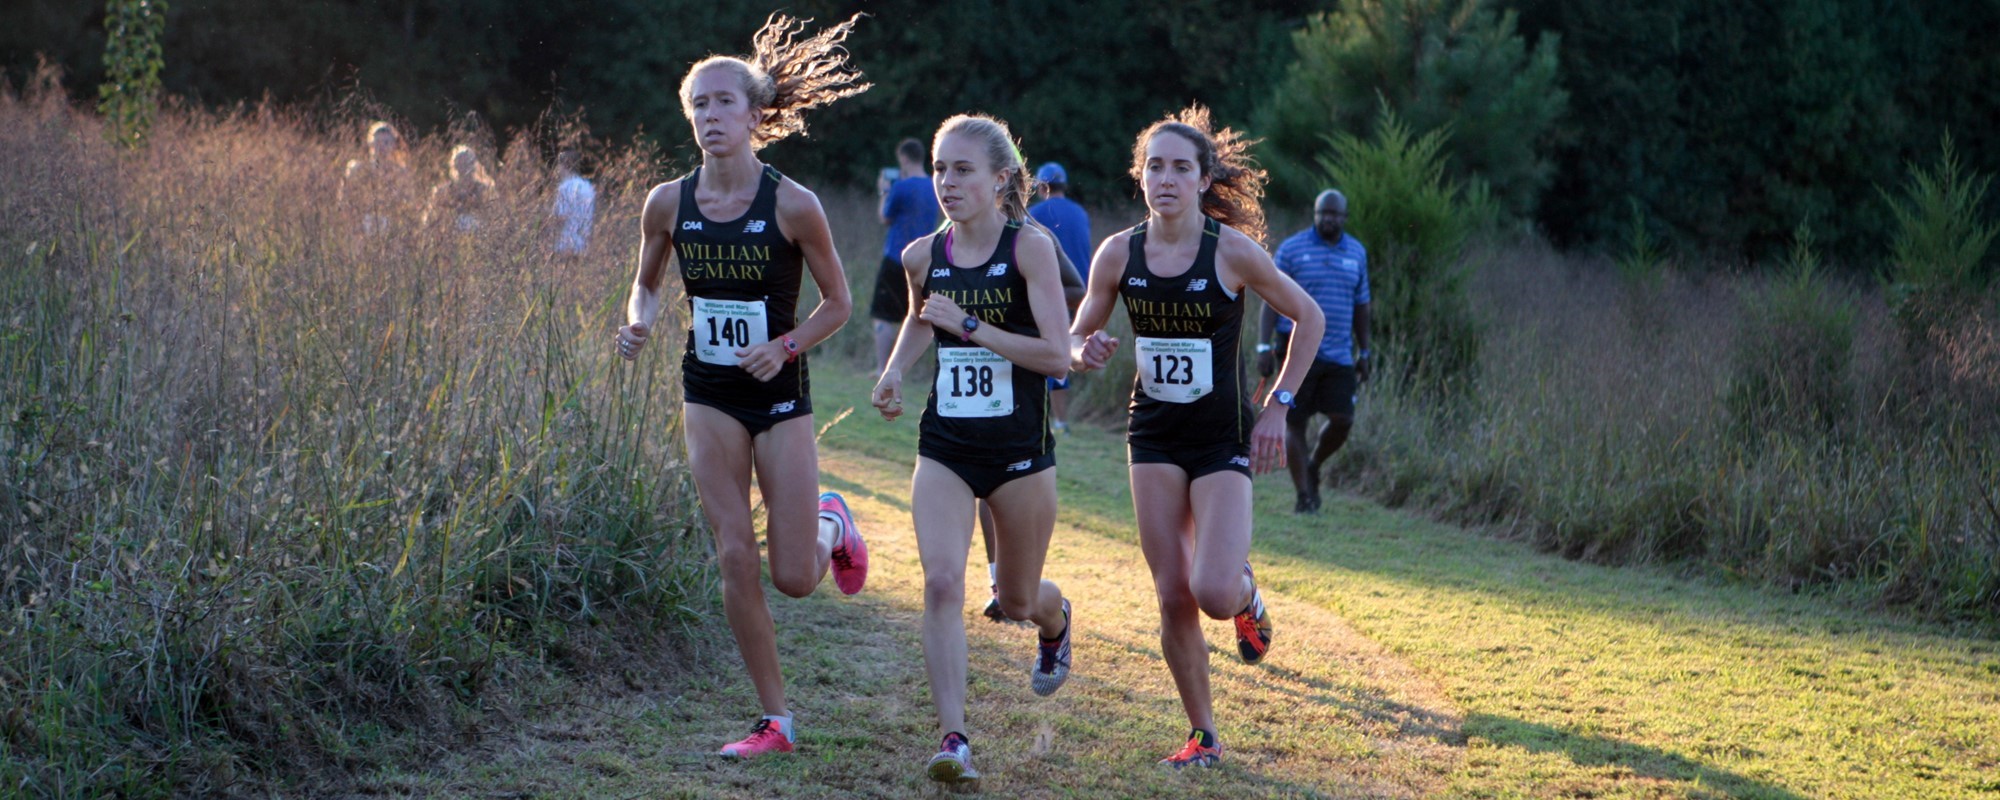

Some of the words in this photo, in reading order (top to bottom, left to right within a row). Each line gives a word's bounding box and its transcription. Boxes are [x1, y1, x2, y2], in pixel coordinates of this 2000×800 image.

[682, 221, 702, 231] CAA
[680, 242, 771, 261] WILLIAM
[932, 268, 951, 278] CAA
[1128, 277, 1147, 288] CAA
[709, 308, 730, 316] Country
[1127, 297, 1212, 318] WILLIAM
[707, 316, 750, 348] 140
[1152, 354, 1193, 385] 123
[950, 365, 993, 398] 138
